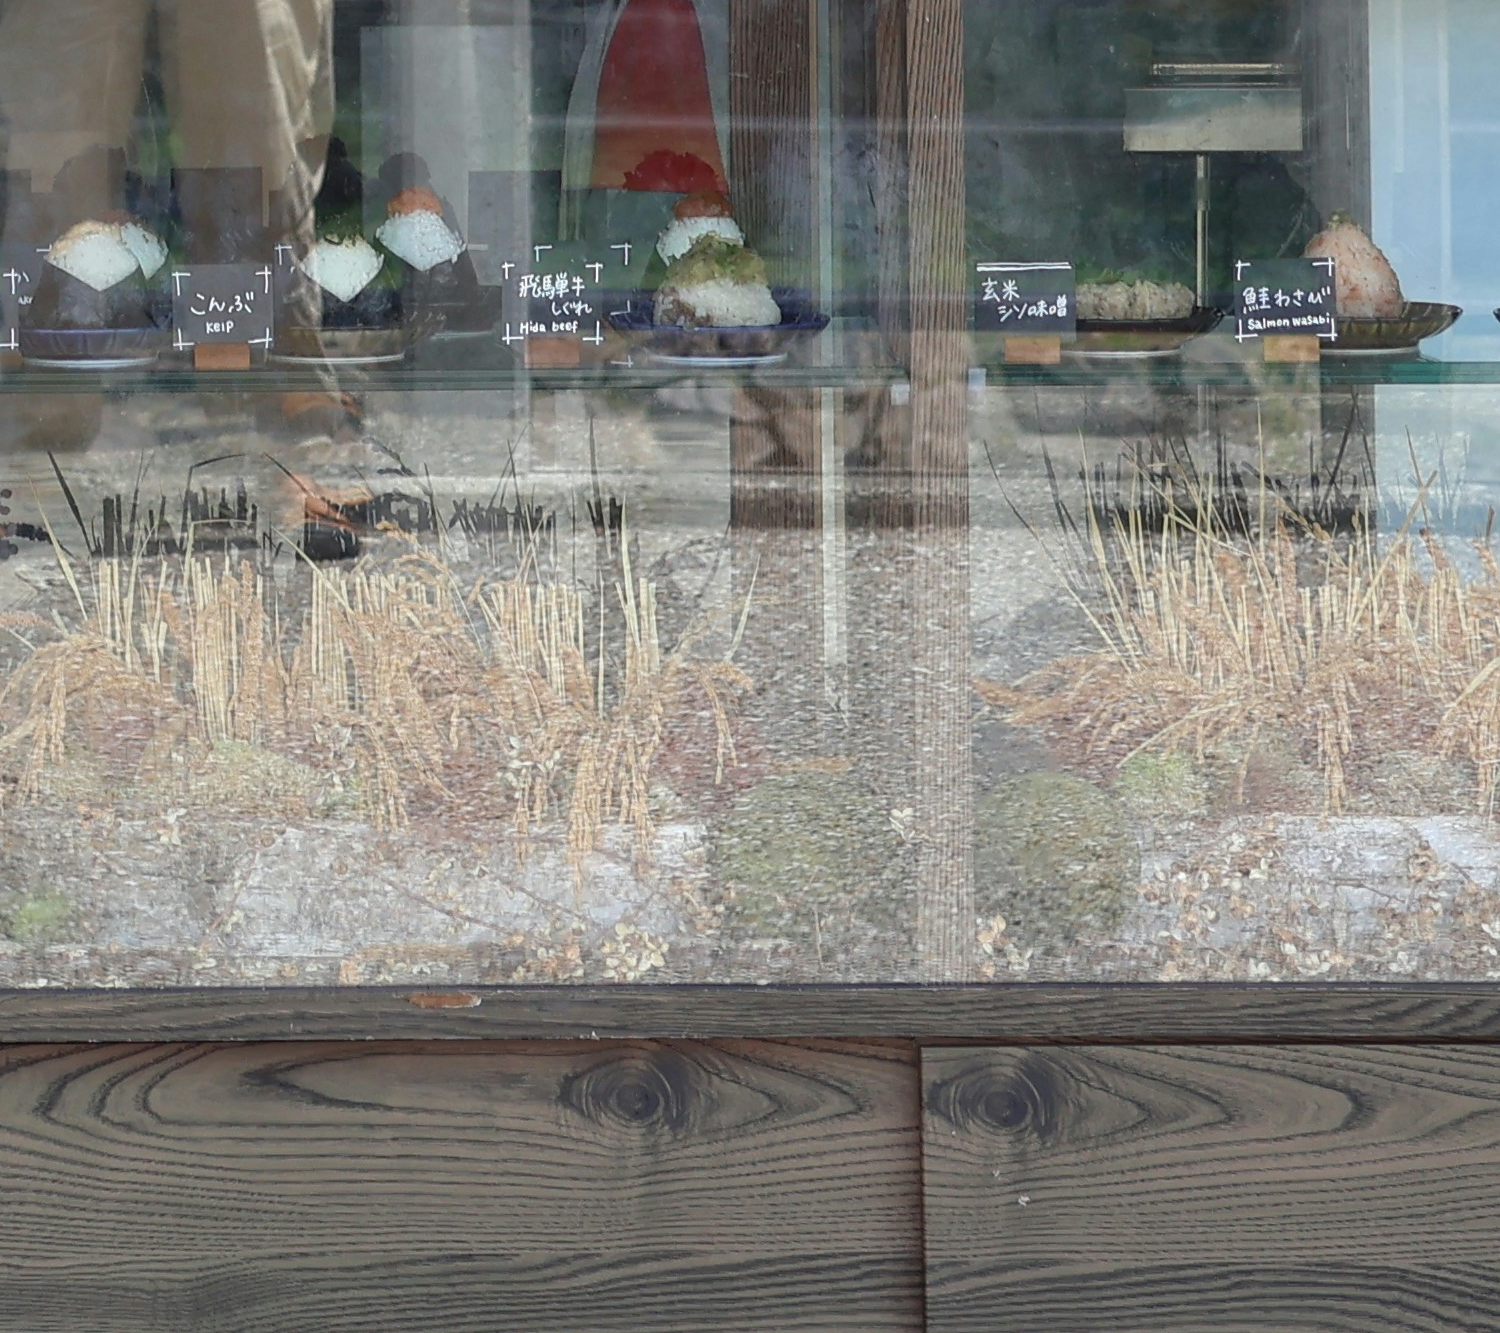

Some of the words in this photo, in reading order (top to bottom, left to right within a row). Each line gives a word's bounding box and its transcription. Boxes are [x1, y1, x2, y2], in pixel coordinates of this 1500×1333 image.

[519, 272, 586, 300] 飛騨牛
[981, 277, 1020, 302] 玄米
[191, 291, 255, 316] こんぶ
[552, 300, 593, 317] しぐれ
[997, 294, 1067, 322] シソ味噌
[1242, 286, 1331, 315] 鮭わさび
[520, 321, 546, 334] Hida
[552, 320, 579, 334] beef
[1247, 317, 1290, 331] Salmon
